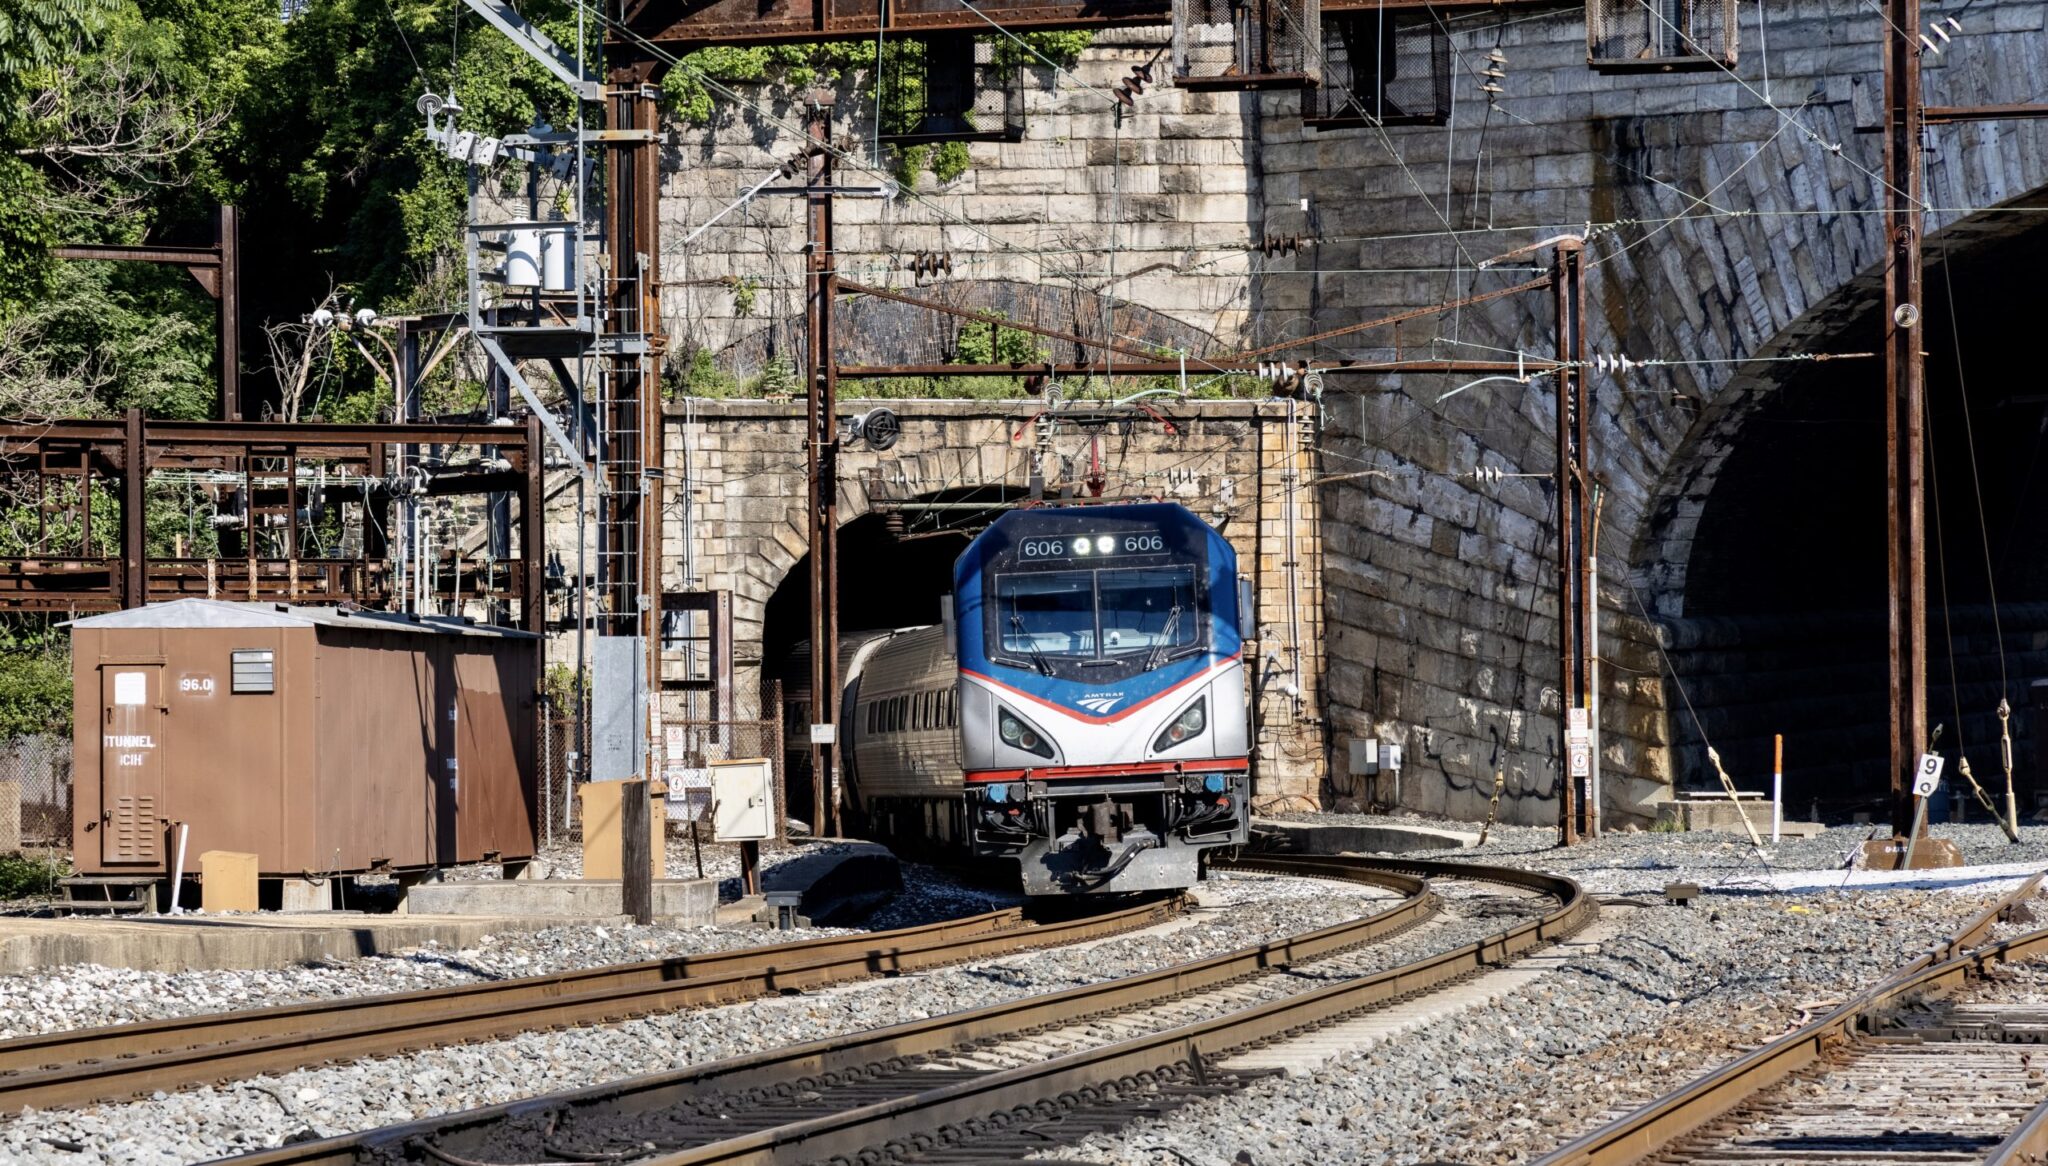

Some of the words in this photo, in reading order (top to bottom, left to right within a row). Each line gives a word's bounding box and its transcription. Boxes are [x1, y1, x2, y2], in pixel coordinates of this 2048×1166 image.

[1025, 541, 1063, 556] 606
[1125, 536, 1163, 551] 606
[1925, 758, 1937, 775] 9
